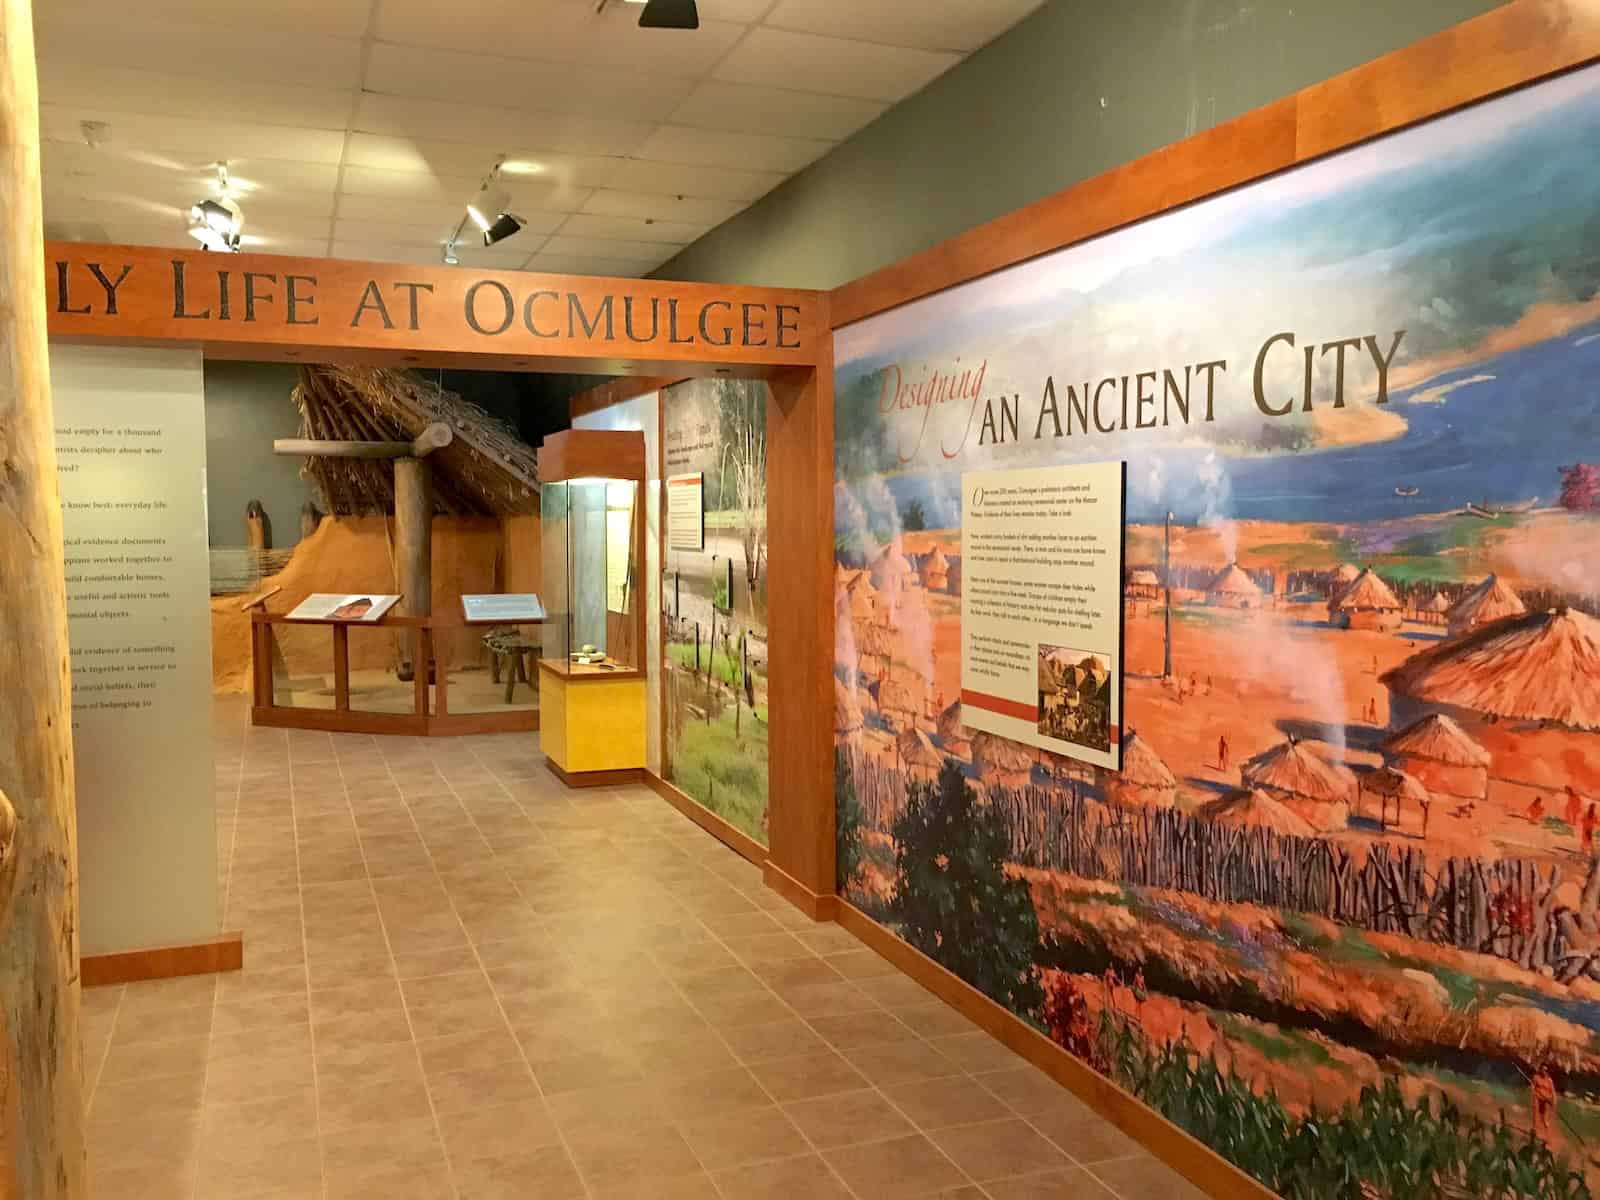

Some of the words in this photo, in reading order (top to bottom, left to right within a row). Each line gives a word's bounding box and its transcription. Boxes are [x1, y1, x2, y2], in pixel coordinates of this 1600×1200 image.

[56, 261, 132, 314] LY
[171, 260, 319, 325] LIFE
[350, 280, 434, 331] AT
[464, 279, 801, 348] OCMULGEE
[978, 393, 1020, 446] AN
[1033, 359, 1227, 440] ANCIENT
[1253, 330, 1408, 417] CITY
[880, 357, 987, 462] Designing
[102, 428, 113, 436] for
[124, 428, 161, 438] thousand
[115, 502, 152, 513] everyday
[121, 537, 167, 546] documents
[126, 555, 161, 568] together
[163, 555, 174, 563] to
[102, 592, 117, 601] and
[122, 646, 131, 655] of
[133, 645, 176, 657] something
